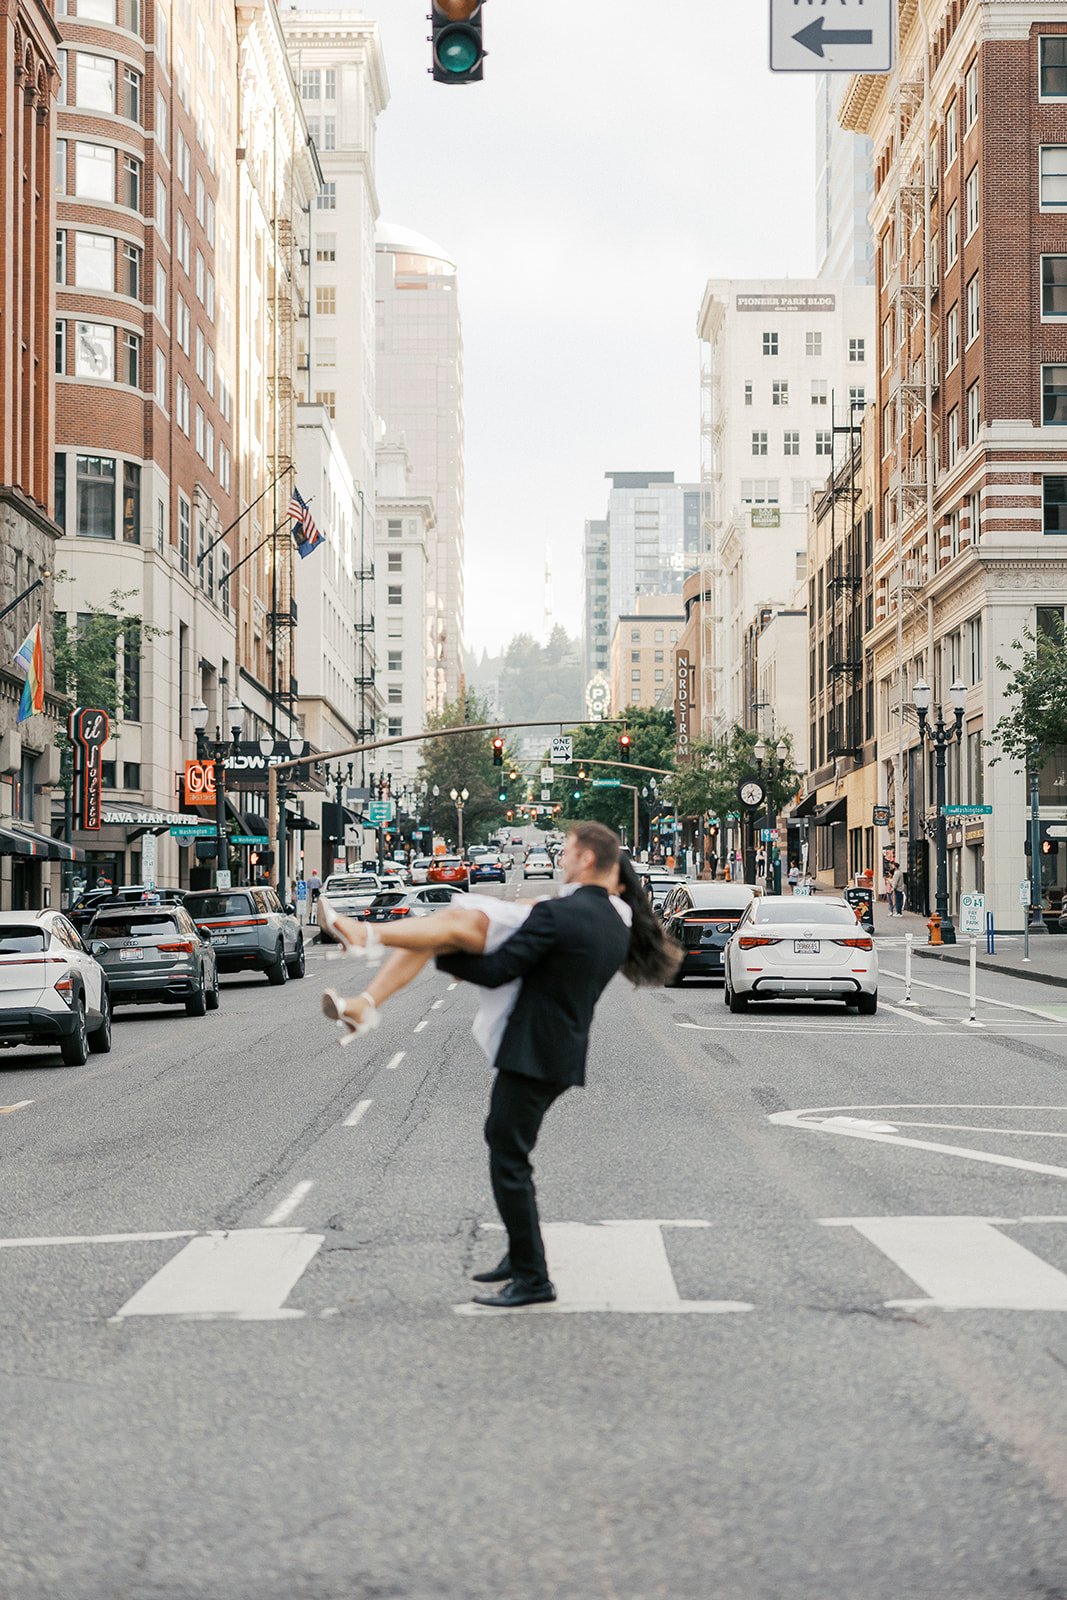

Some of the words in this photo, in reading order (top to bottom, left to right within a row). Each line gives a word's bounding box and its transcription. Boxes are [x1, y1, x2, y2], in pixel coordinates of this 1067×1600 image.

[738, 298, 780, 306] PIONEER
[780, 298, 806, 306] PARK
[807, 298, 835, 306] BLDG.
[678, 657, 688, 755] NORDSTROM
[104, 813, 134, 823] JAVA
[136, 813, 163, 824] MAN
[166, 815, 198, 825] COFFEE
